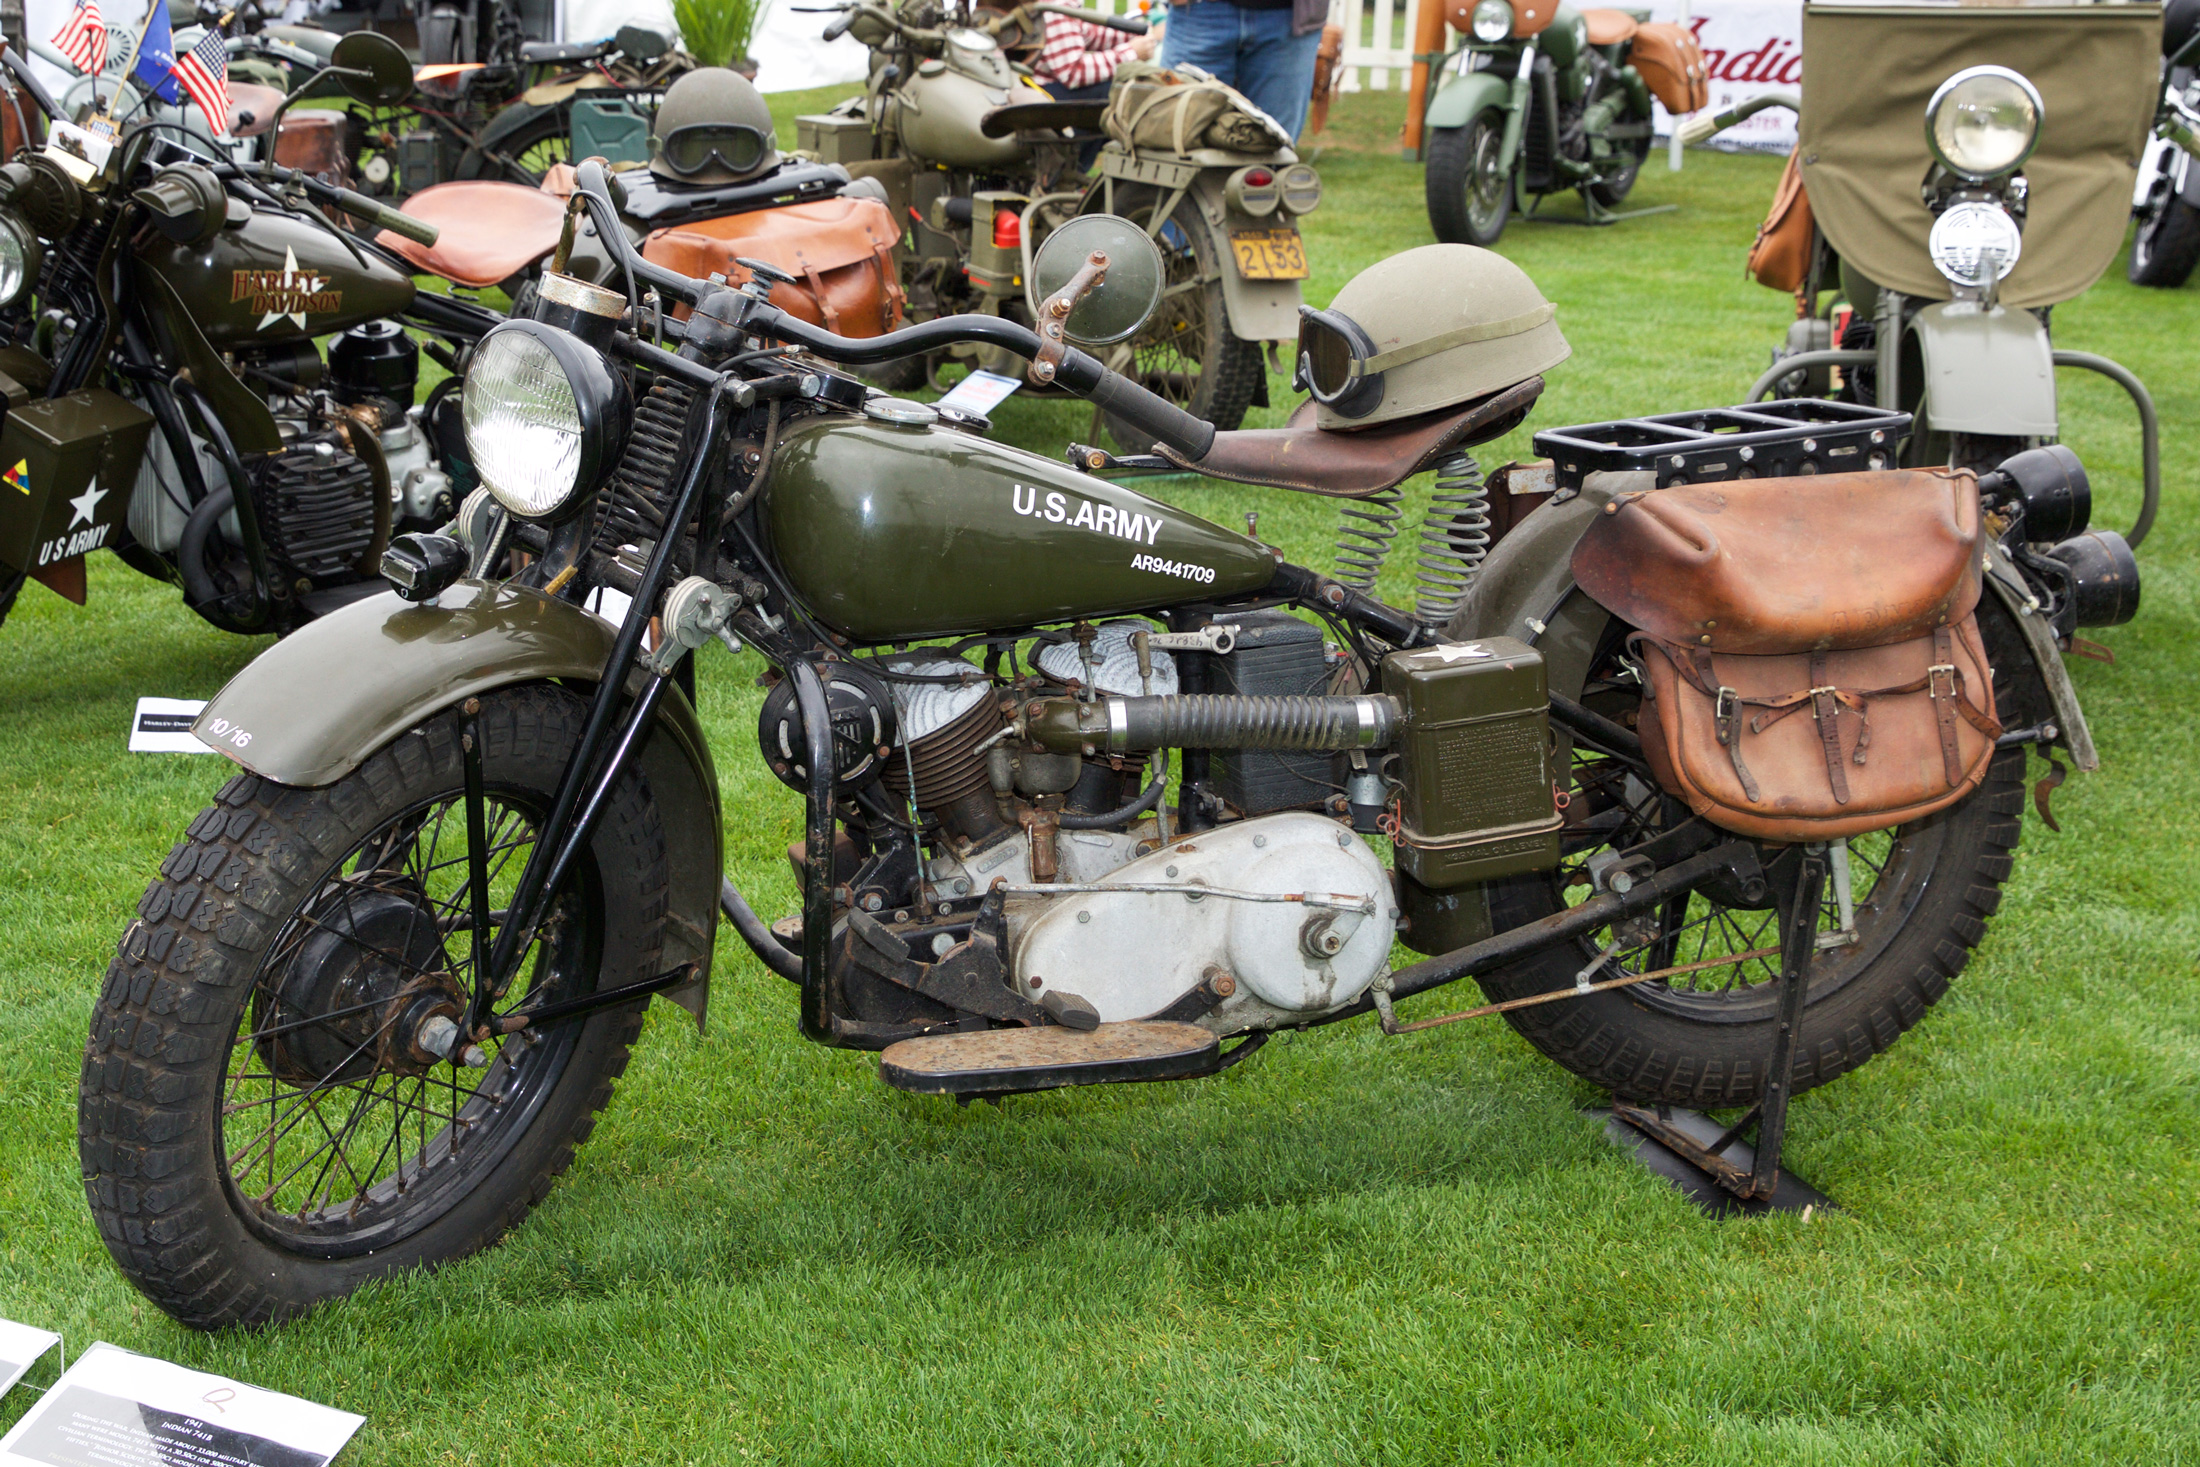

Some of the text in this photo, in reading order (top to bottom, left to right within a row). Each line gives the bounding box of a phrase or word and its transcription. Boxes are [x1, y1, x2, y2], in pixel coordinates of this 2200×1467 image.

[1690, 17, 1802, 84] ndia
[1241, 245, 1302, 271] 2153
[230, 269, 332, 304] HARLEY-
[250, 291, 343, 316] DAVIDSON
[1012, 484, 1164, 545] U.S.ARMY
[64, 523, 111, 558] ARMY
[1131, 553, 1216, 584] AR9441709
[208, 717, 253, 748] 10/16
[1492, 844, 1510, 854] OIL
[1512, 839, 1547, 851] LEVEL
[71, 1421, 89, 1430] MANY
[91, 1425, 109, 1434] WERE
[108, 1430, 132, 1442] MODEL
[149, 1442, 168, 1451] WITH
[72, 1411, 100, 1424] DURING
[100, 1419, 113, 1427] THE
[129, 1428, 155, 1439] INDIAN
[155, 1435, 174, 1444] MADE
[173, 1441, 197, 1451] ABOUT
[217, 1454, 250, 1466] MILITARY
[161, 1421, 214, 1441] INDIAN 741B
[184, 1418, 204, 1429] 1941
[57, 1425, 86, 1437] CIVILIAN
[134, 1446, 148, 1455] THE
